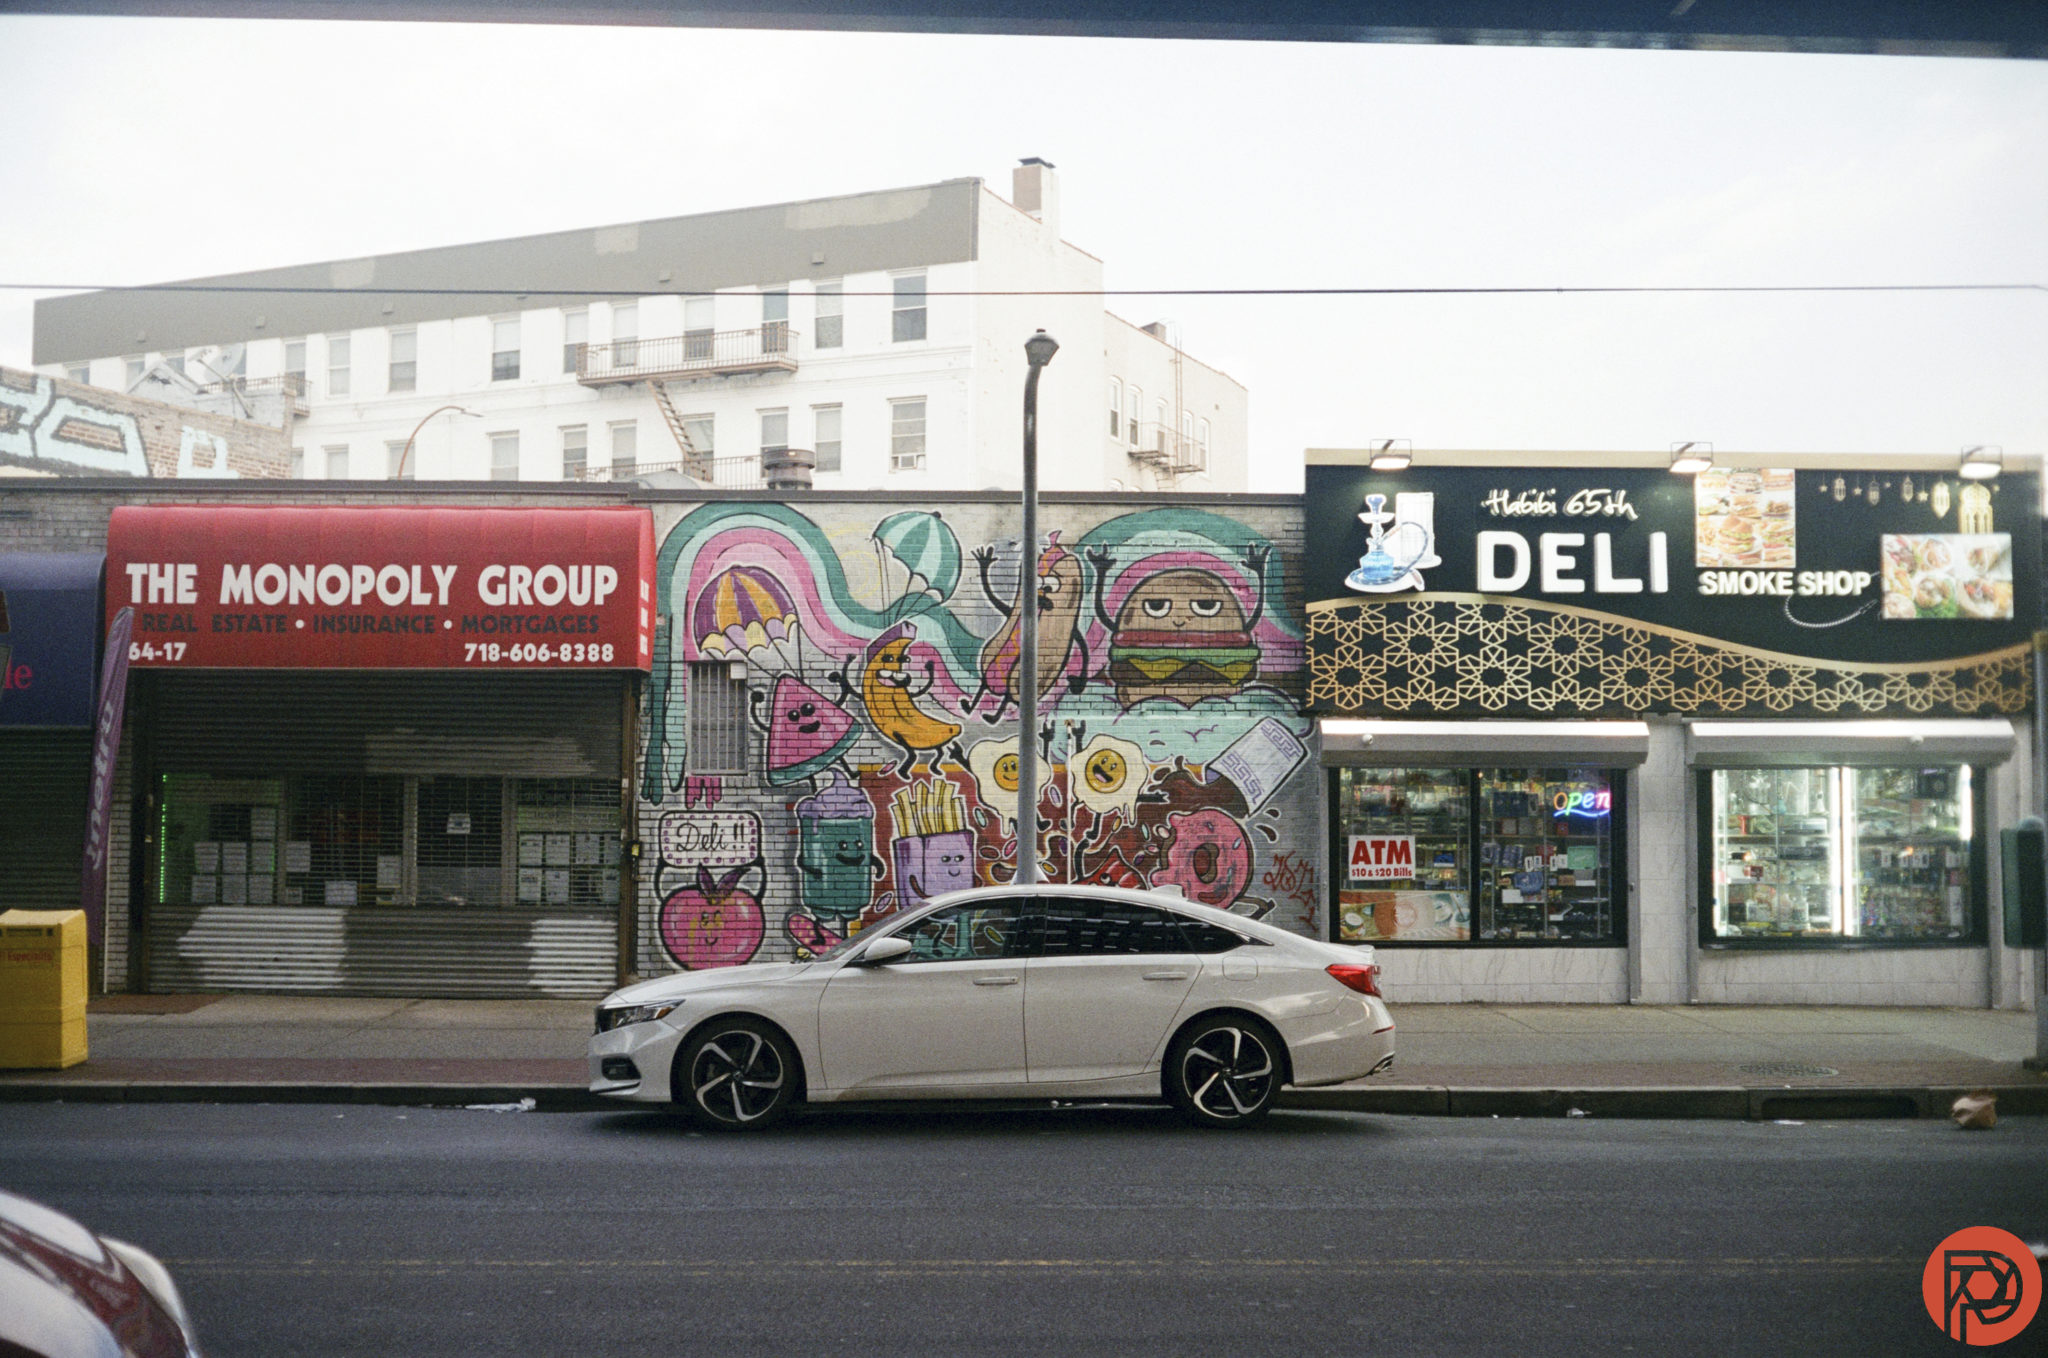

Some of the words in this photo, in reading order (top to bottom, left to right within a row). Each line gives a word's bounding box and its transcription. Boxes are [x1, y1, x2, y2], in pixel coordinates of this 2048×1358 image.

[1482, 488, 1557, 516] Habibi
[1563, 488, 1639, 520] 65th
[1477, 530, 1669, 593] DELI
[125, 563, 198, 604] THE
[219, 563, 457, 606] MONOPOLY
[477, 564, 618, 606] GROUP
[1698, 571, 1795, 595] SMOKE
[1797, 571, 1871, 596] SHOP
[142, 614, 199, 633] REAL
[212, 614, 287, 633] ESTATE
[313, 614, 436, 634] INSURANCE
[460, 614, 599, 634] MORTGAGES
[128, 642, 187, 661] 64-17
[464, 643, 614, 662] 718-606-8388
[677, 822, 728, 852] Deli
[1351, 840, 1412, 865] ATM
[1352, 867, 1366, 877] $10
[1367, 869, 1373, 877] &
[1375, 867, 1391, 877] $20
[1393, 867, 1412, 877] Bills
